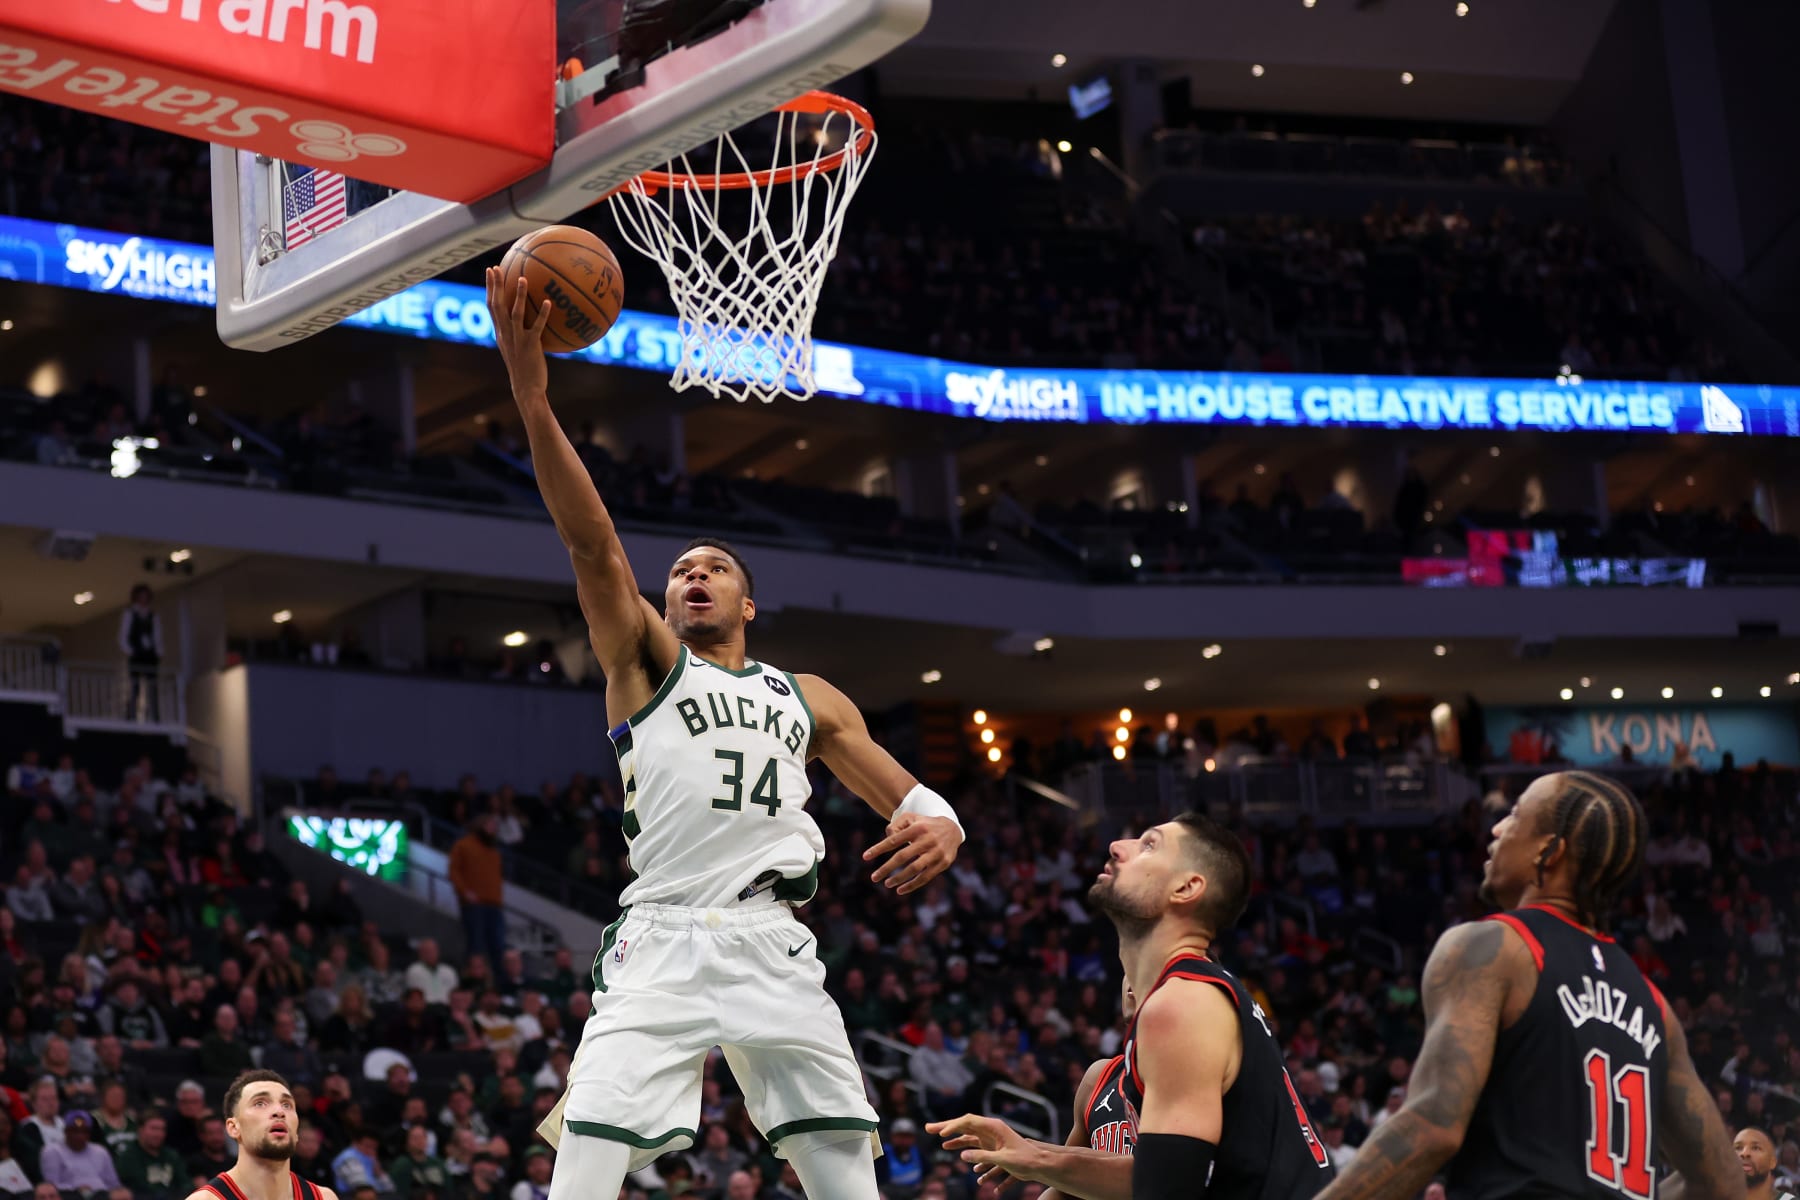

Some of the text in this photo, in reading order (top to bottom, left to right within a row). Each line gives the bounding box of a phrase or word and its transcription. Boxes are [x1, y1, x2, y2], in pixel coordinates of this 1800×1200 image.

[278, 237, 500, 339] SHOP.BUCKS.COM
[1100, 382, 1674, 428] IN-HOUSE CREATIVE SERVICES
[675, 692, 806, 756] BUCKS
[1589, 711, 1717, 756] KONA
[711, 748, 782, 817] 34
[1583, 1047, 1656, 1200] 11
